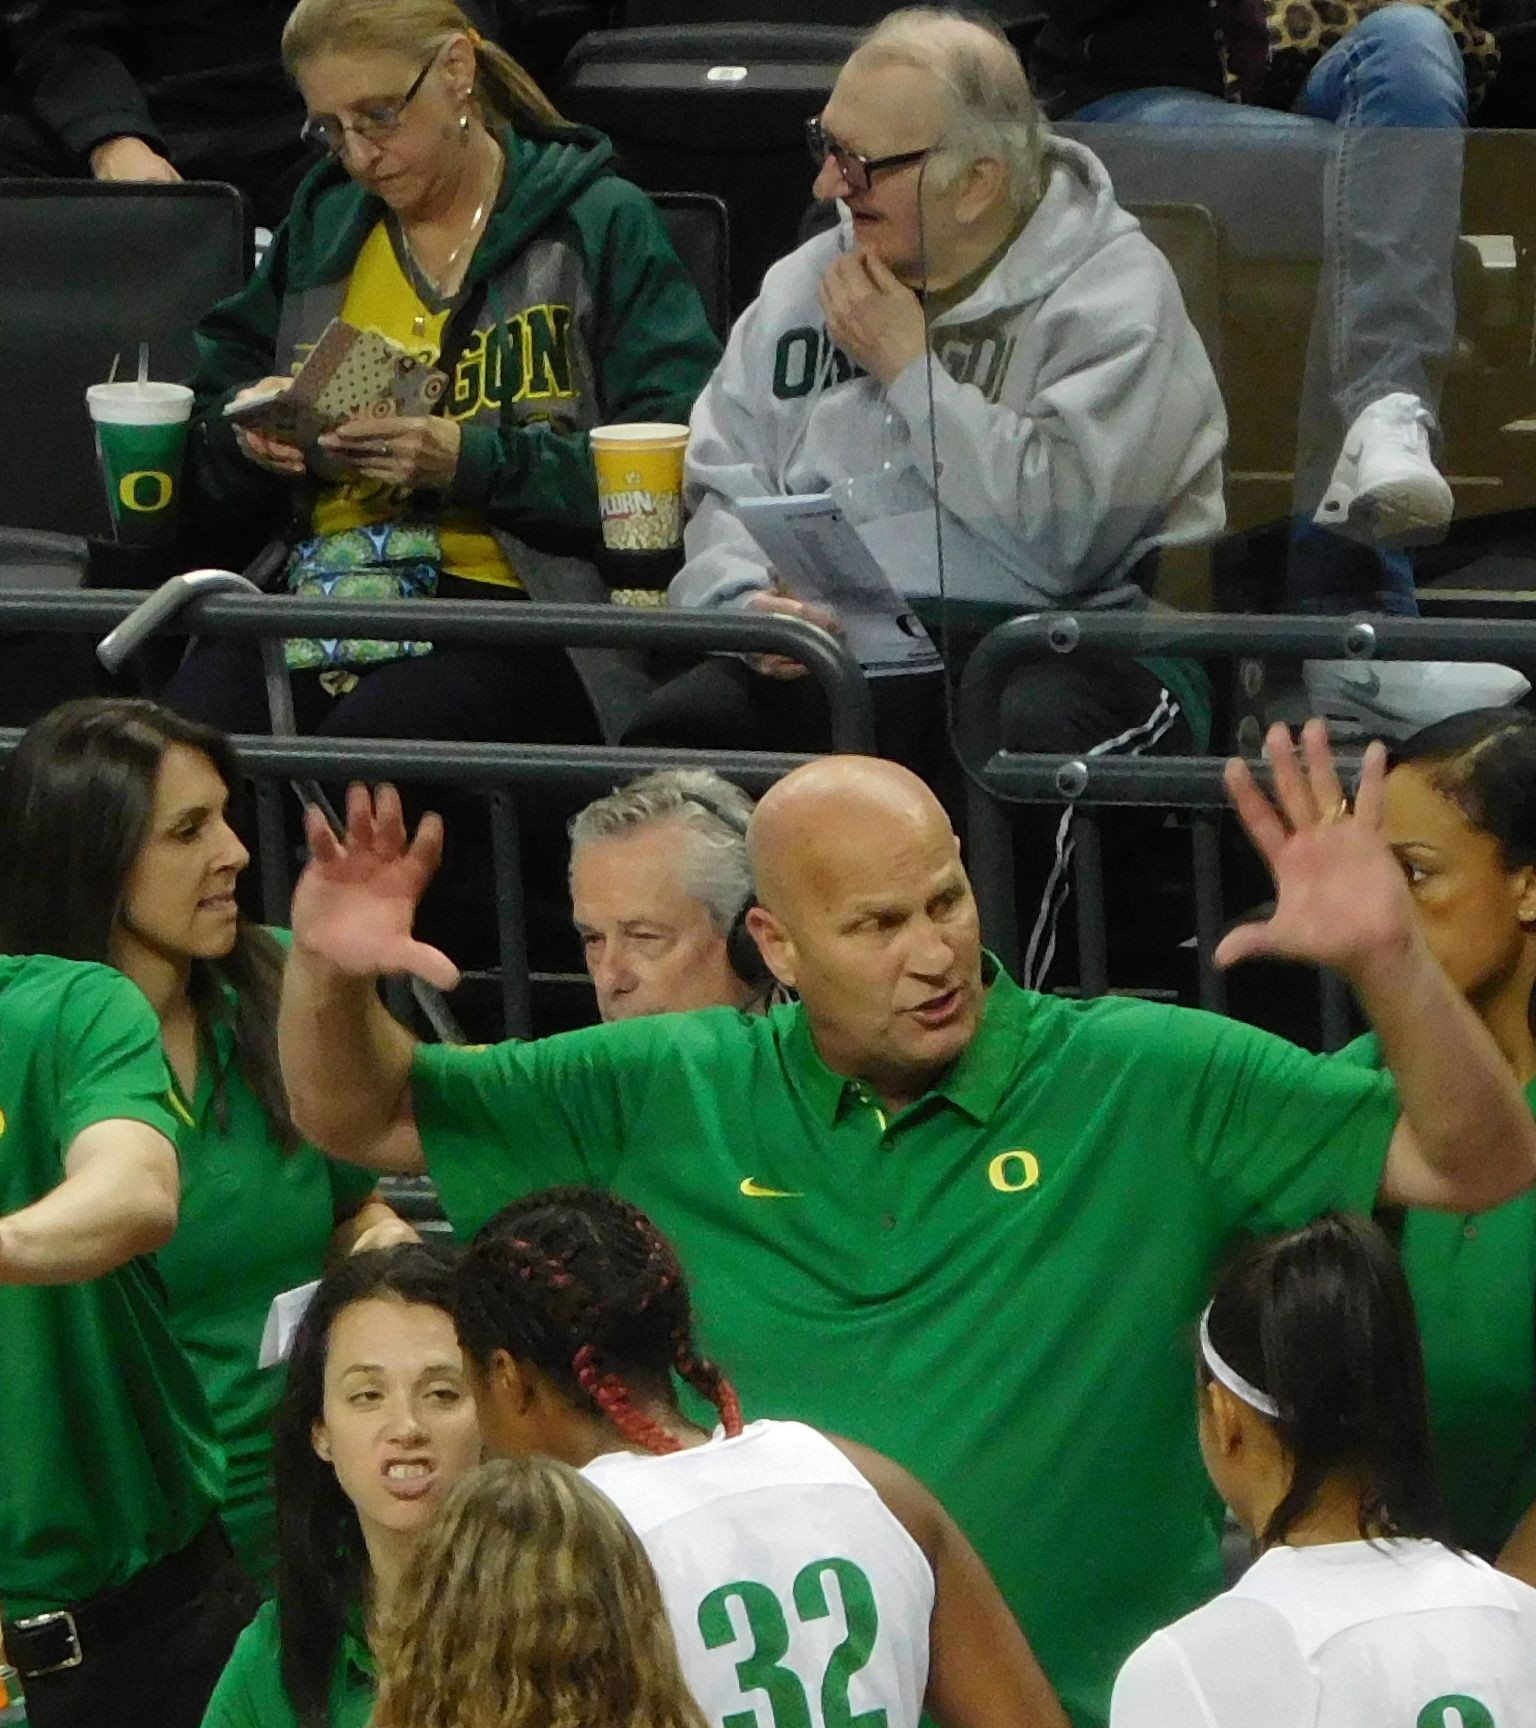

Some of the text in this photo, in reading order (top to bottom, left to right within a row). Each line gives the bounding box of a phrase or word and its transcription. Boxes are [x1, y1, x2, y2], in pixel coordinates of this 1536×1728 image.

[442, 303, 580, 423] GON
[119, 470, 173, 512] O
[988, 1150, 1039, 1192] O
